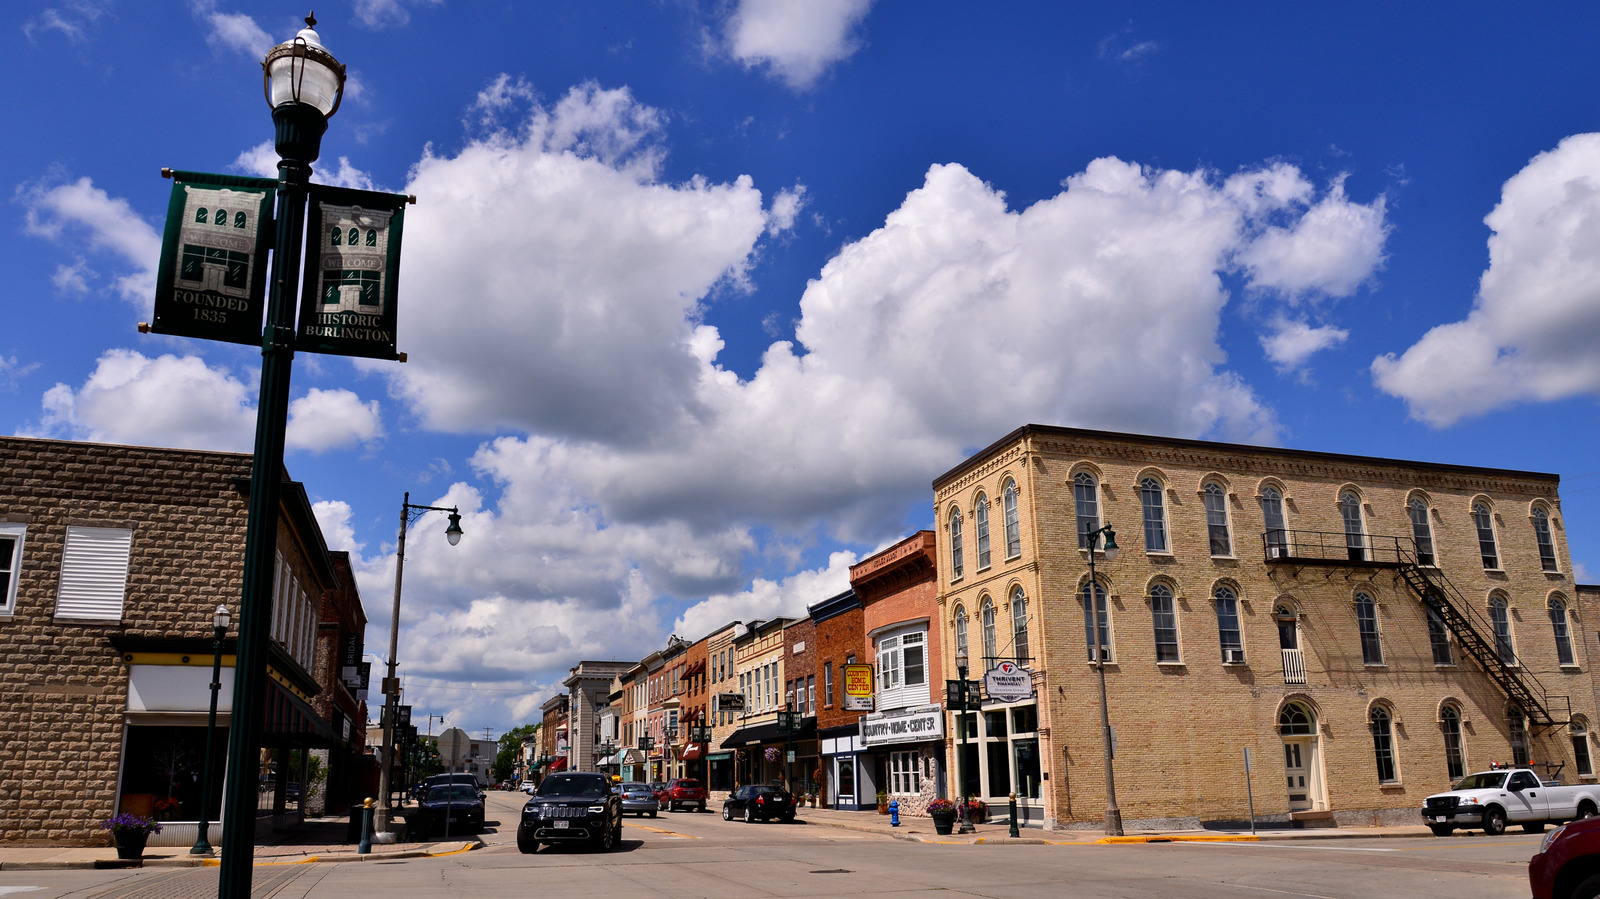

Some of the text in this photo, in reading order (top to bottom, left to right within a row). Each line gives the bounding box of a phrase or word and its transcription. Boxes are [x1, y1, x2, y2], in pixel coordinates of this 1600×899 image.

[190, 234, 246, 250] WELCOME
[327, 258, 377, 268] WELCOME
[173, 290, 249, 312] FOUNDED
[193, 308, 227, 324] 1835
[317, 313, 381, 327] HISTORIC
[305, 325, 391, 342] BURLINGTON
[347, 635, 357, 665] BRIDAL
